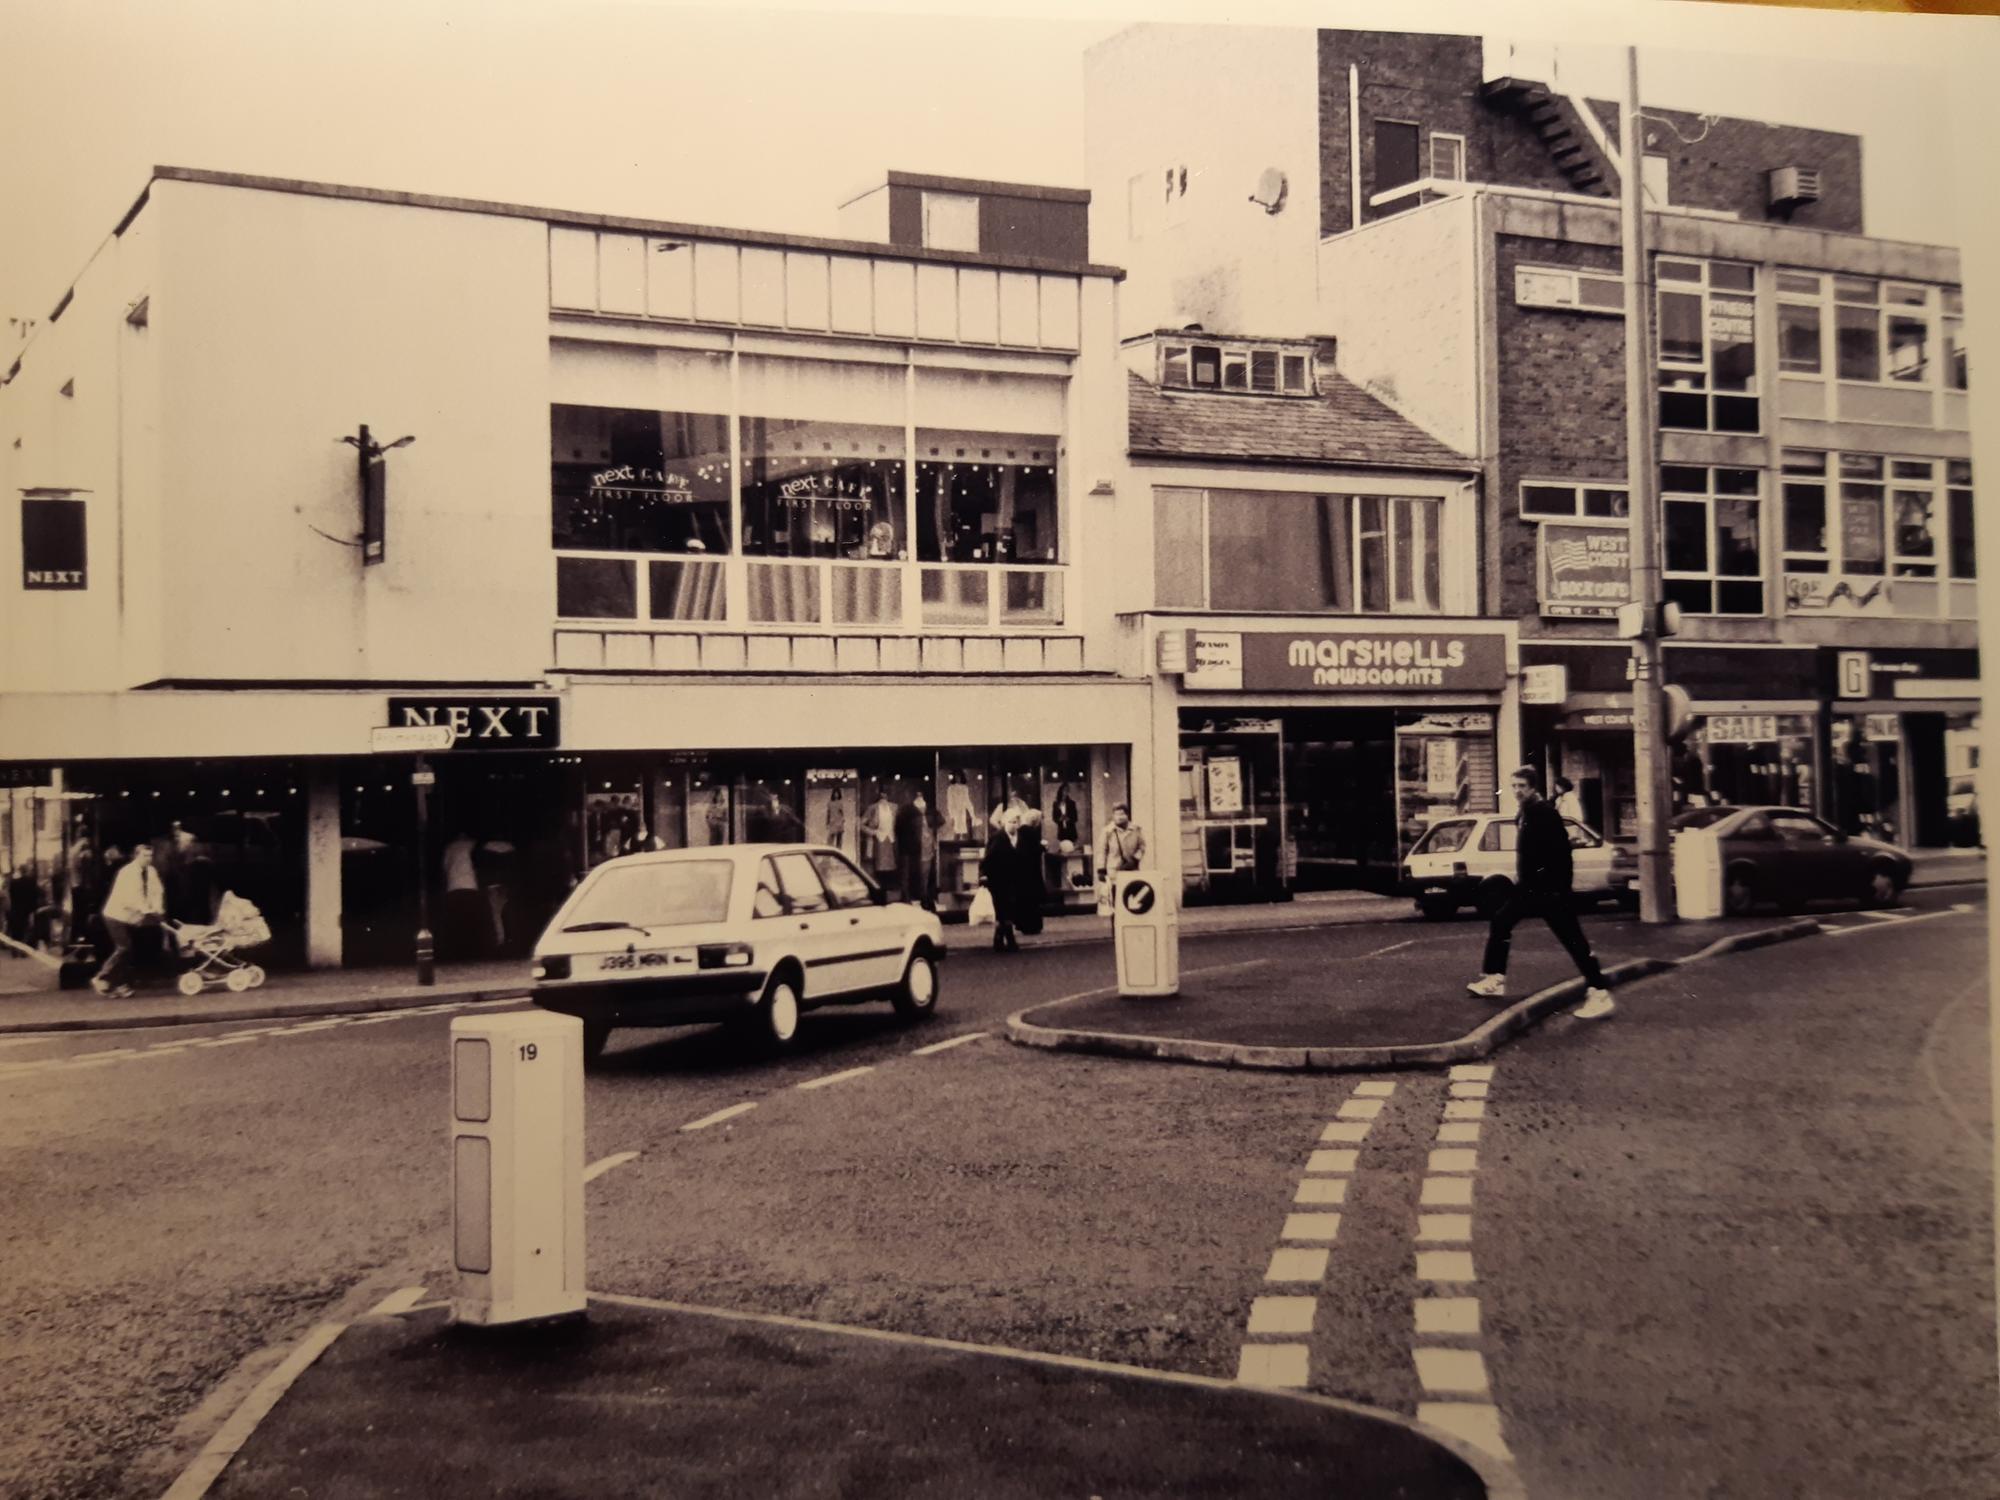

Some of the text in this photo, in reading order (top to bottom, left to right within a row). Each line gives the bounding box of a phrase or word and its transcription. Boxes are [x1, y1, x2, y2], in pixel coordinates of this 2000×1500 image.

[593, 465, 635, 487] next
[781, 475, 819, 497] next
[1586, 535, 1627, 552] WEST
[1588, 551, 1629, 568] COAST
[27, 570, 83, 583] NEXT
[1846, 658, 1861, 693] G
[403, 706, 550, 738] NEXT
[1711, 717, 1773, 740] SALE
[519, 1043, 538, 1062] 19
